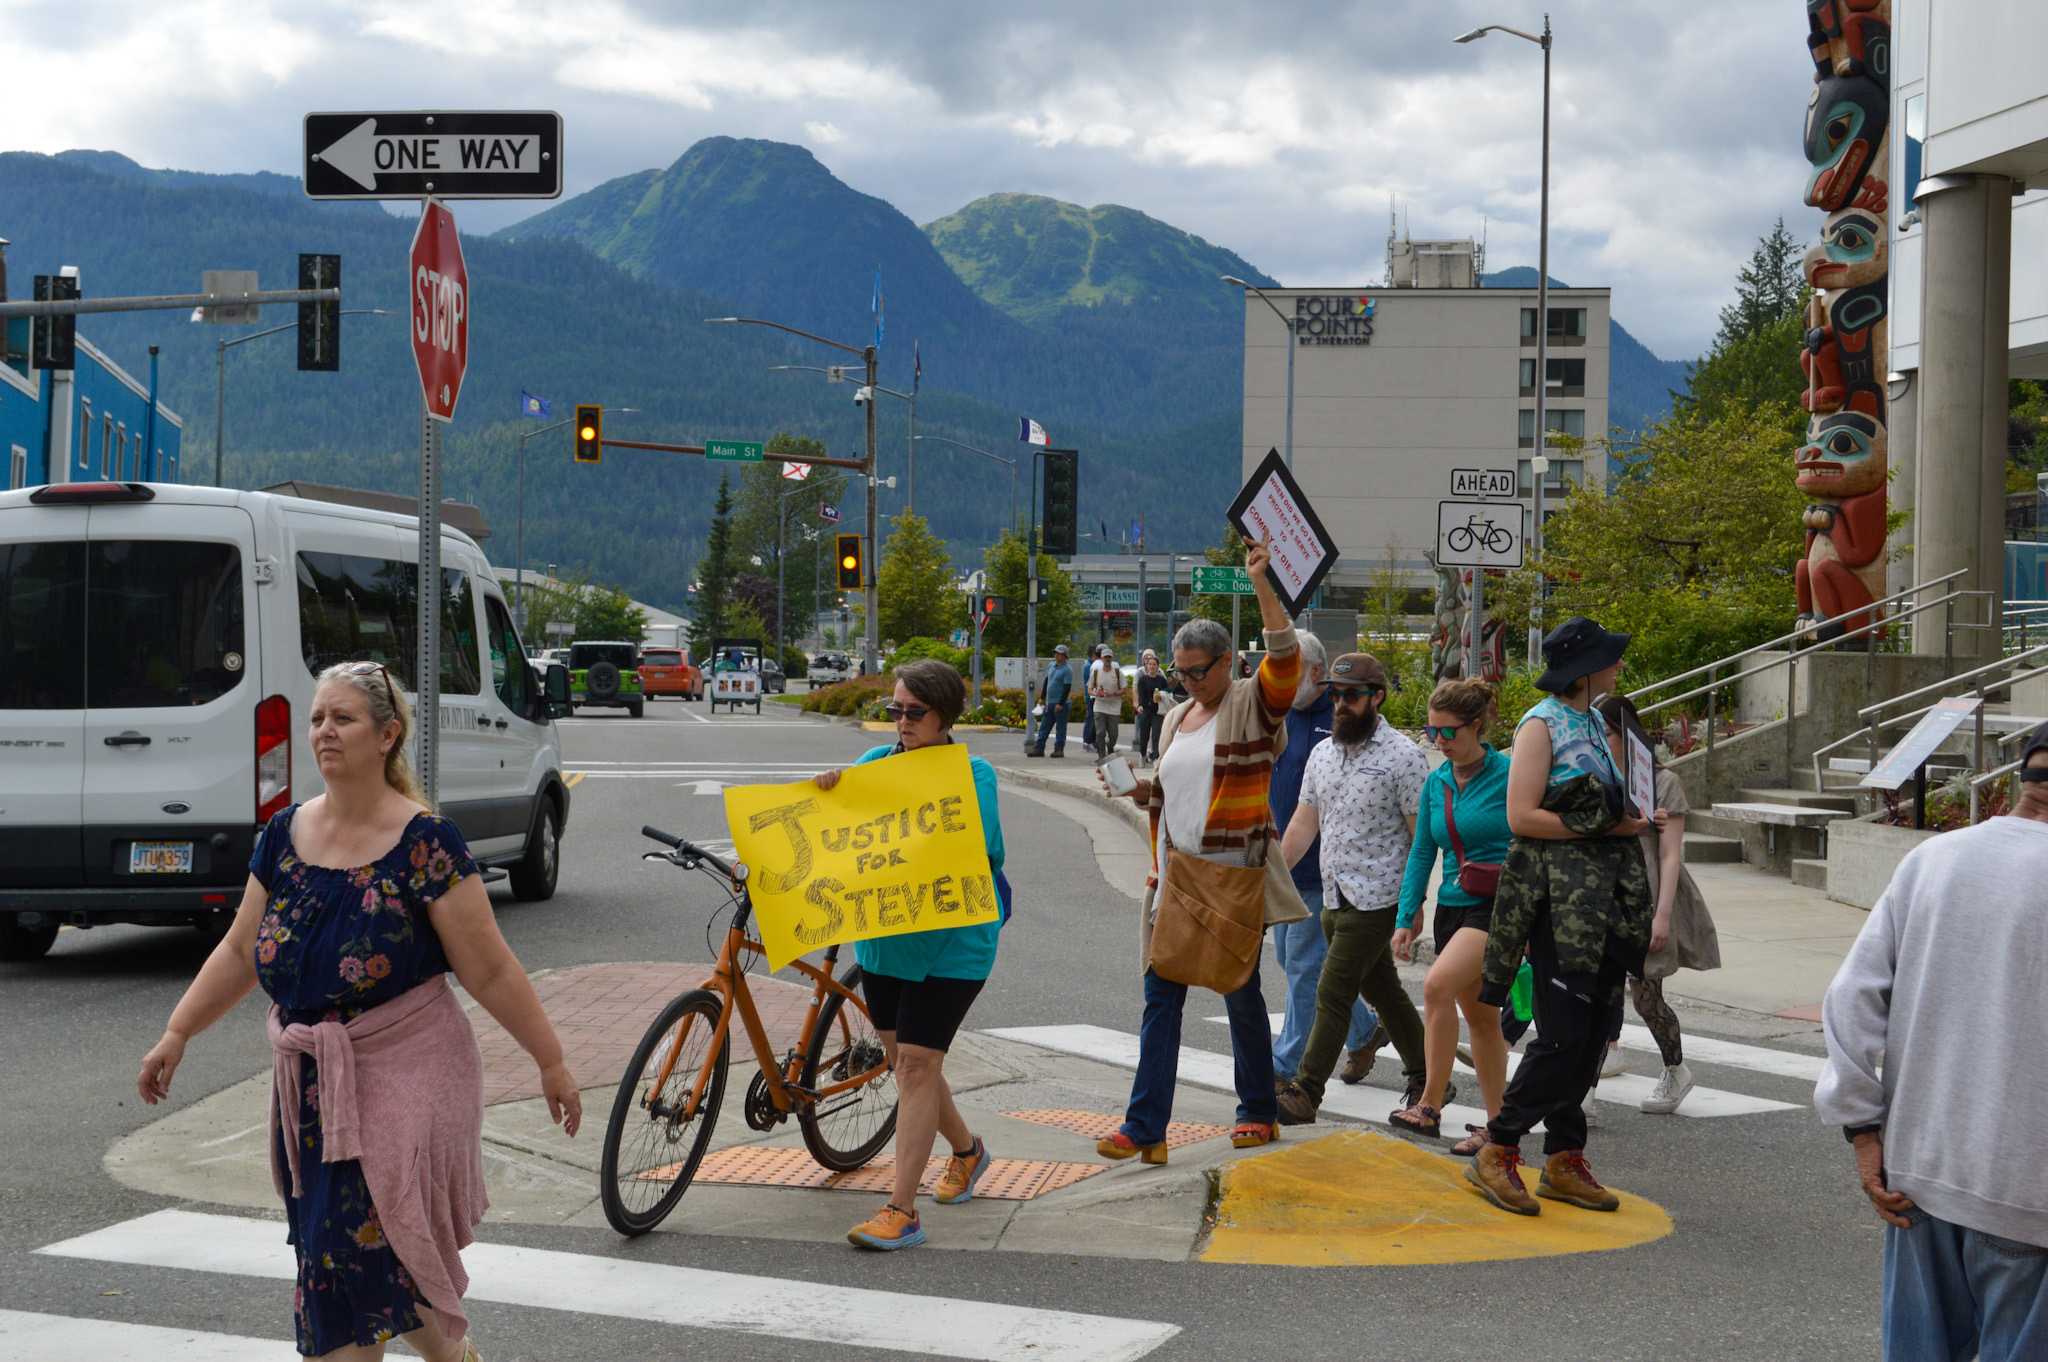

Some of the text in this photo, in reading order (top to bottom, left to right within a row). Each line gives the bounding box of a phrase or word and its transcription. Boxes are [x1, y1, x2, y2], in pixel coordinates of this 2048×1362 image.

[374, 139, 530, 170] ONE WAY
[416, 265, 464, 353] STOP
[1296, 297, 1355, 316] FOUR
[1296, 317, 1373, 335] POINTS
[1299, 336, 1370, 345] BY SHERATON
[712, 445, 756, 457] Main St
[1457, 474, 1509, 491] AHEAD
[1268, 494, 1310, 560] PROTECT & SERVE
[1270, 476, 1321, 558] WHEN DID WE GO FROM
[1280, 530, 1287, 542] TO
[1281, 554, 1292, 571] DIE
[1291, 571, 1302, 587] ???
[1107, 592, 1139, 601] TRANSIT
[749, 796, 966, 894] JUSTICE
[165, 849, 190, 867] 359
[856, 848, 908, 874] FOR
[793, 874, 995, 944] STEVEN
